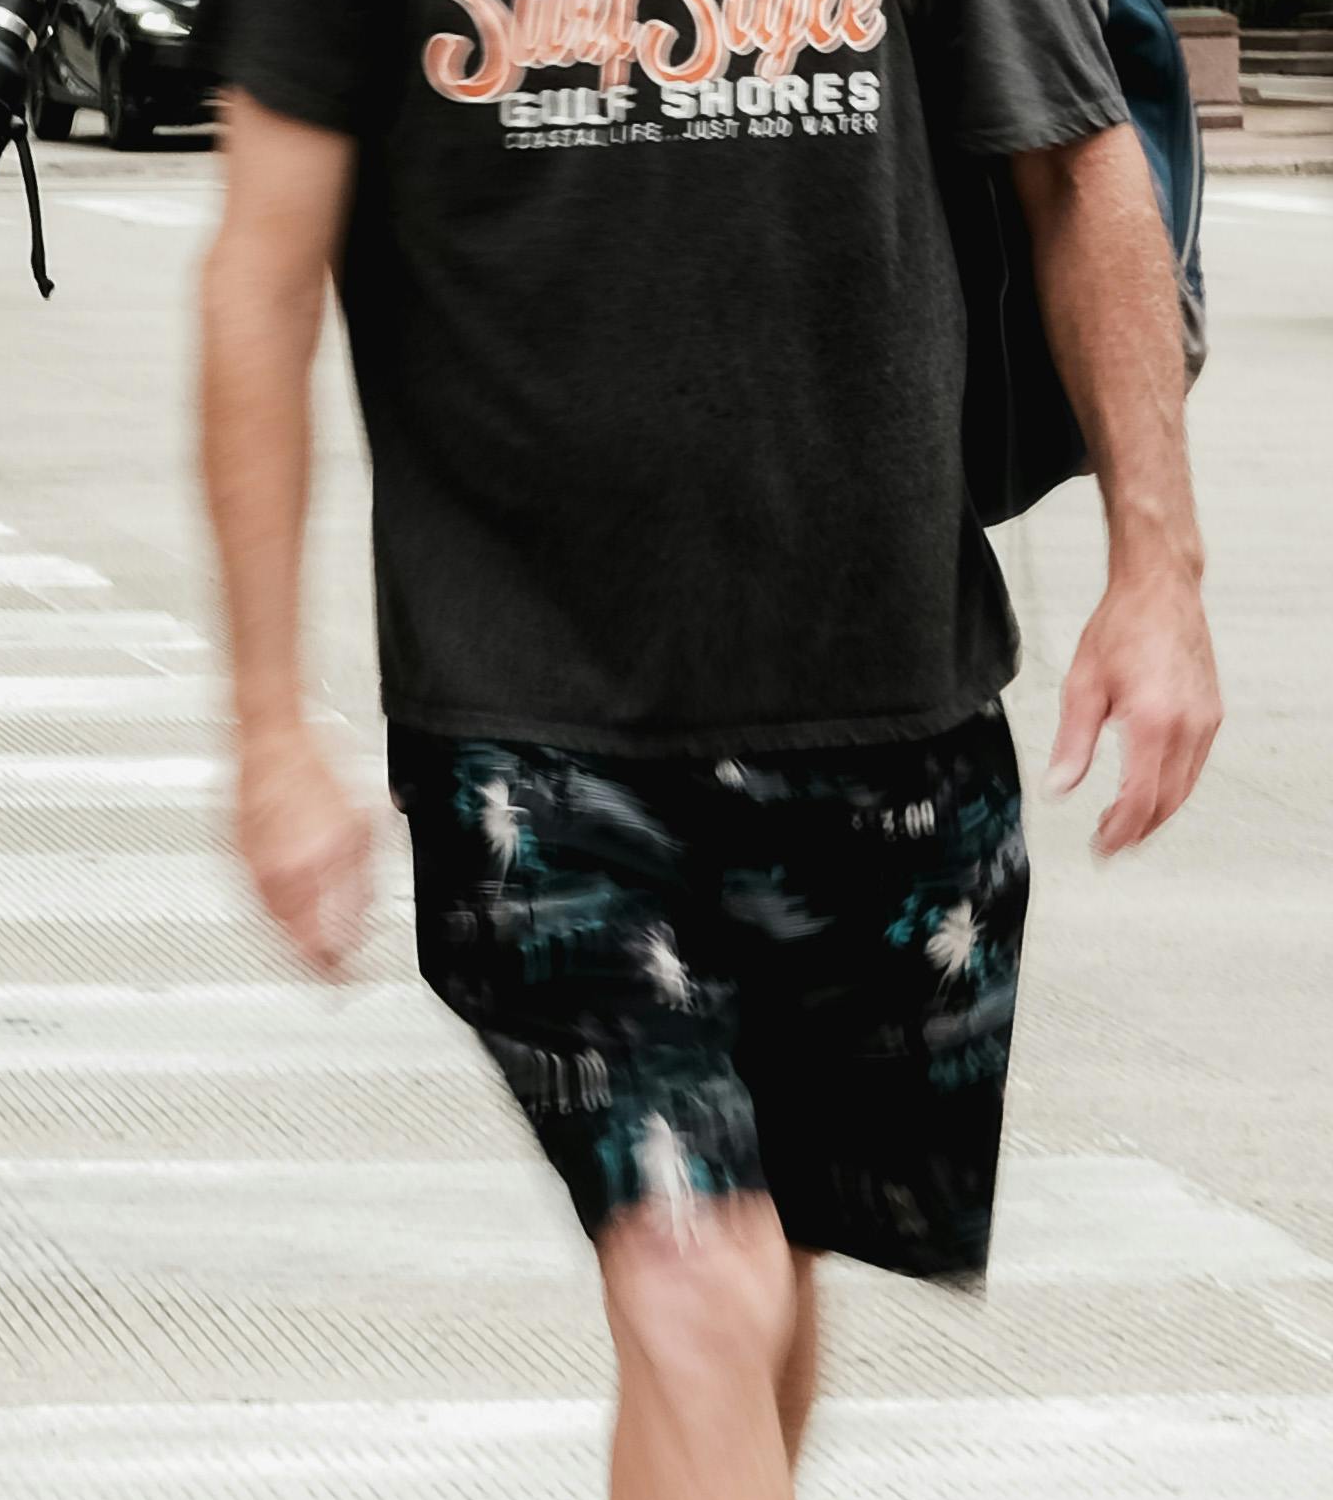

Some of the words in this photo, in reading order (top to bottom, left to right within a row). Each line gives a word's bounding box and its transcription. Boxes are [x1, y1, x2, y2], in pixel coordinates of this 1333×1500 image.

[499, 83, 637, 127] GULF
[661, 70, 881, 121] SHORES
[747, 117, 793, 137] ADD
[802, 113, 878, 136] WATER
